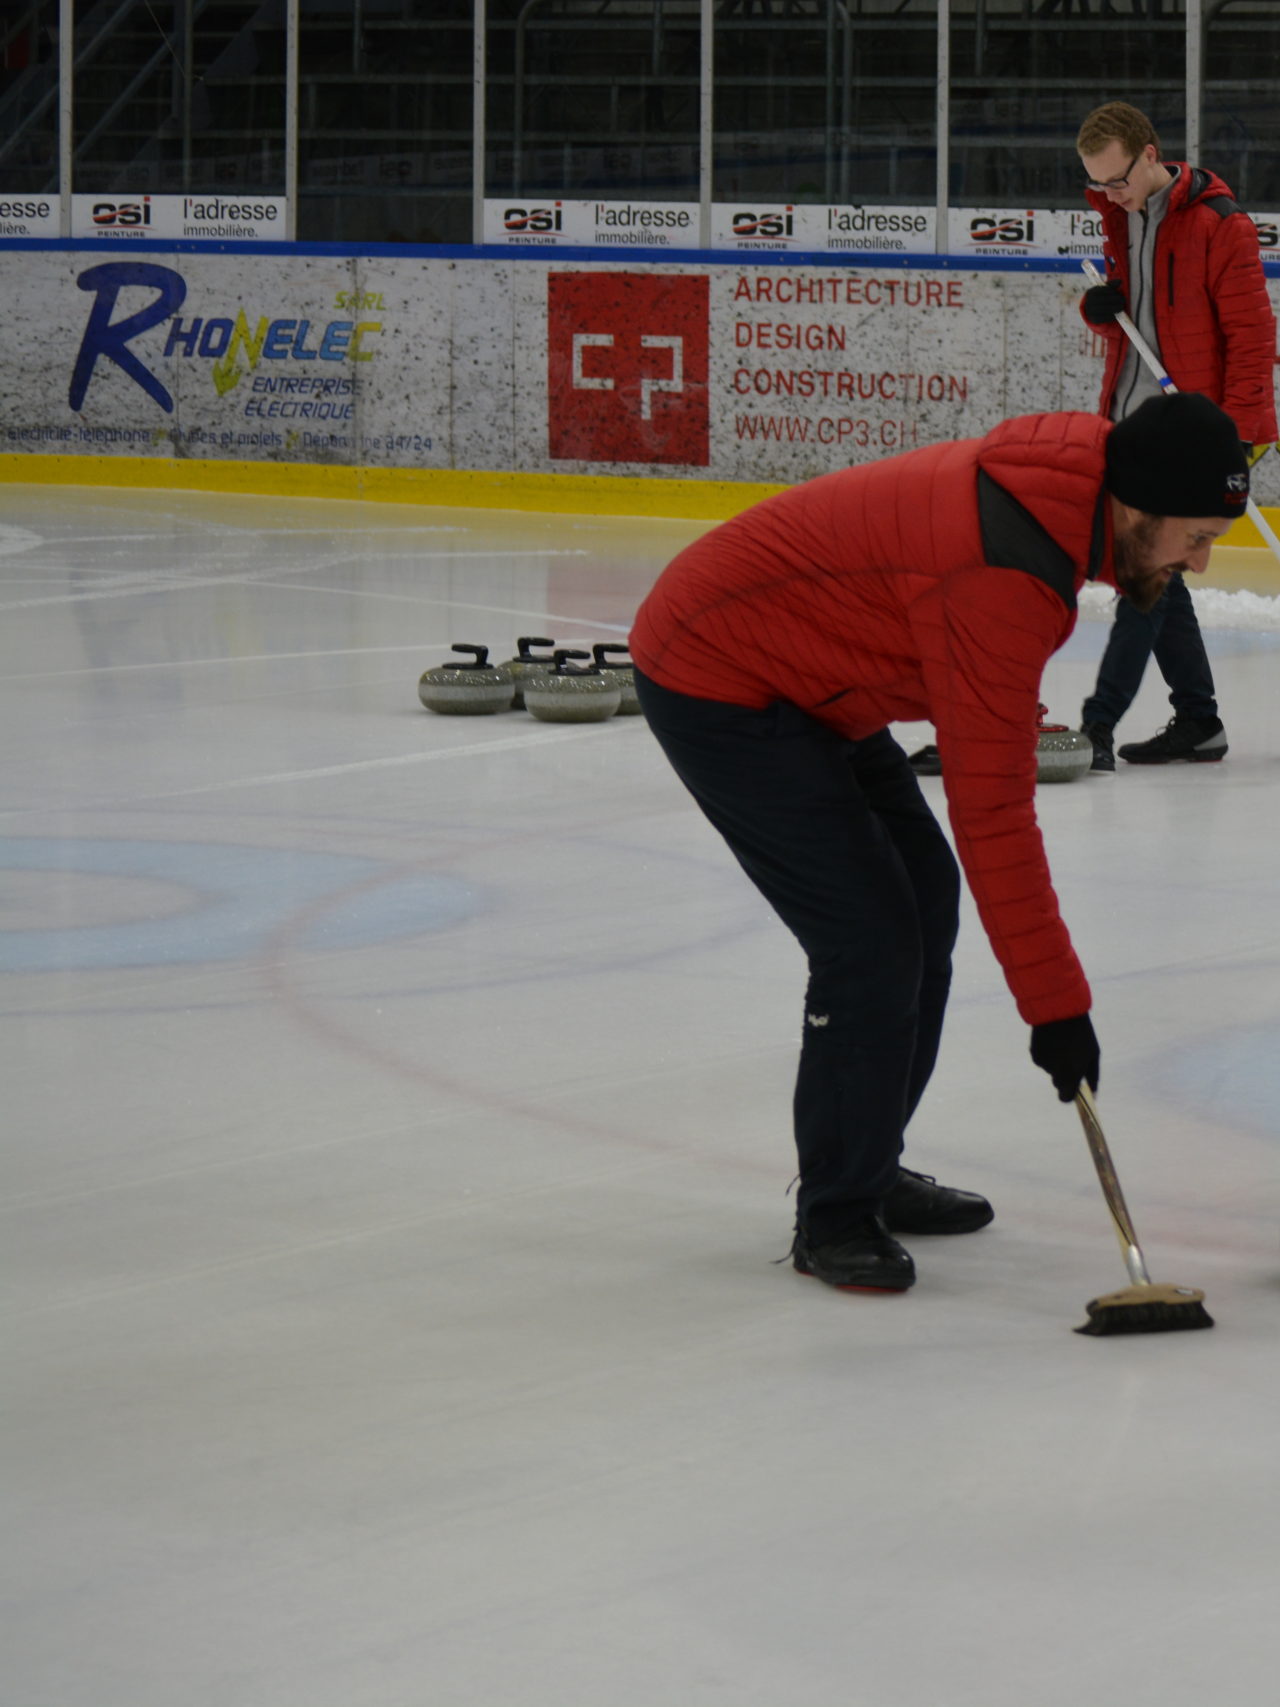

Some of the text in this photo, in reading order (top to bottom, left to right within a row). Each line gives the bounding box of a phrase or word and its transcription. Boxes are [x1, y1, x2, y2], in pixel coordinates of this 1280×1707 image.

[183, 198, 278, 221] l'adresse
[595, 204, 690, 228] l'adresse
[828, 208, 927, 232] l'adresse
[97, 230, 146, 238] PEINTURE
[183, 224, 259, 238] immobilière.
[595, 230, 670, 245] immobilière.
[828, 235, 907, 250] immobilière.
[975, 248, 1028, 256] PEINTURE
[333, 290, 387, 311] SARL
[734, 276, 964, 308] ARCHITECTURE
[68, 261, 382, 414] RHONELEC
[735, 322, 846, 350] DESIGN
[251, 376, 364, 396] ENTREPRISE
[733, 368, 968, 402] CONSTRUCTION
[735, 414, 918, 446] WWW.CP3.CH
